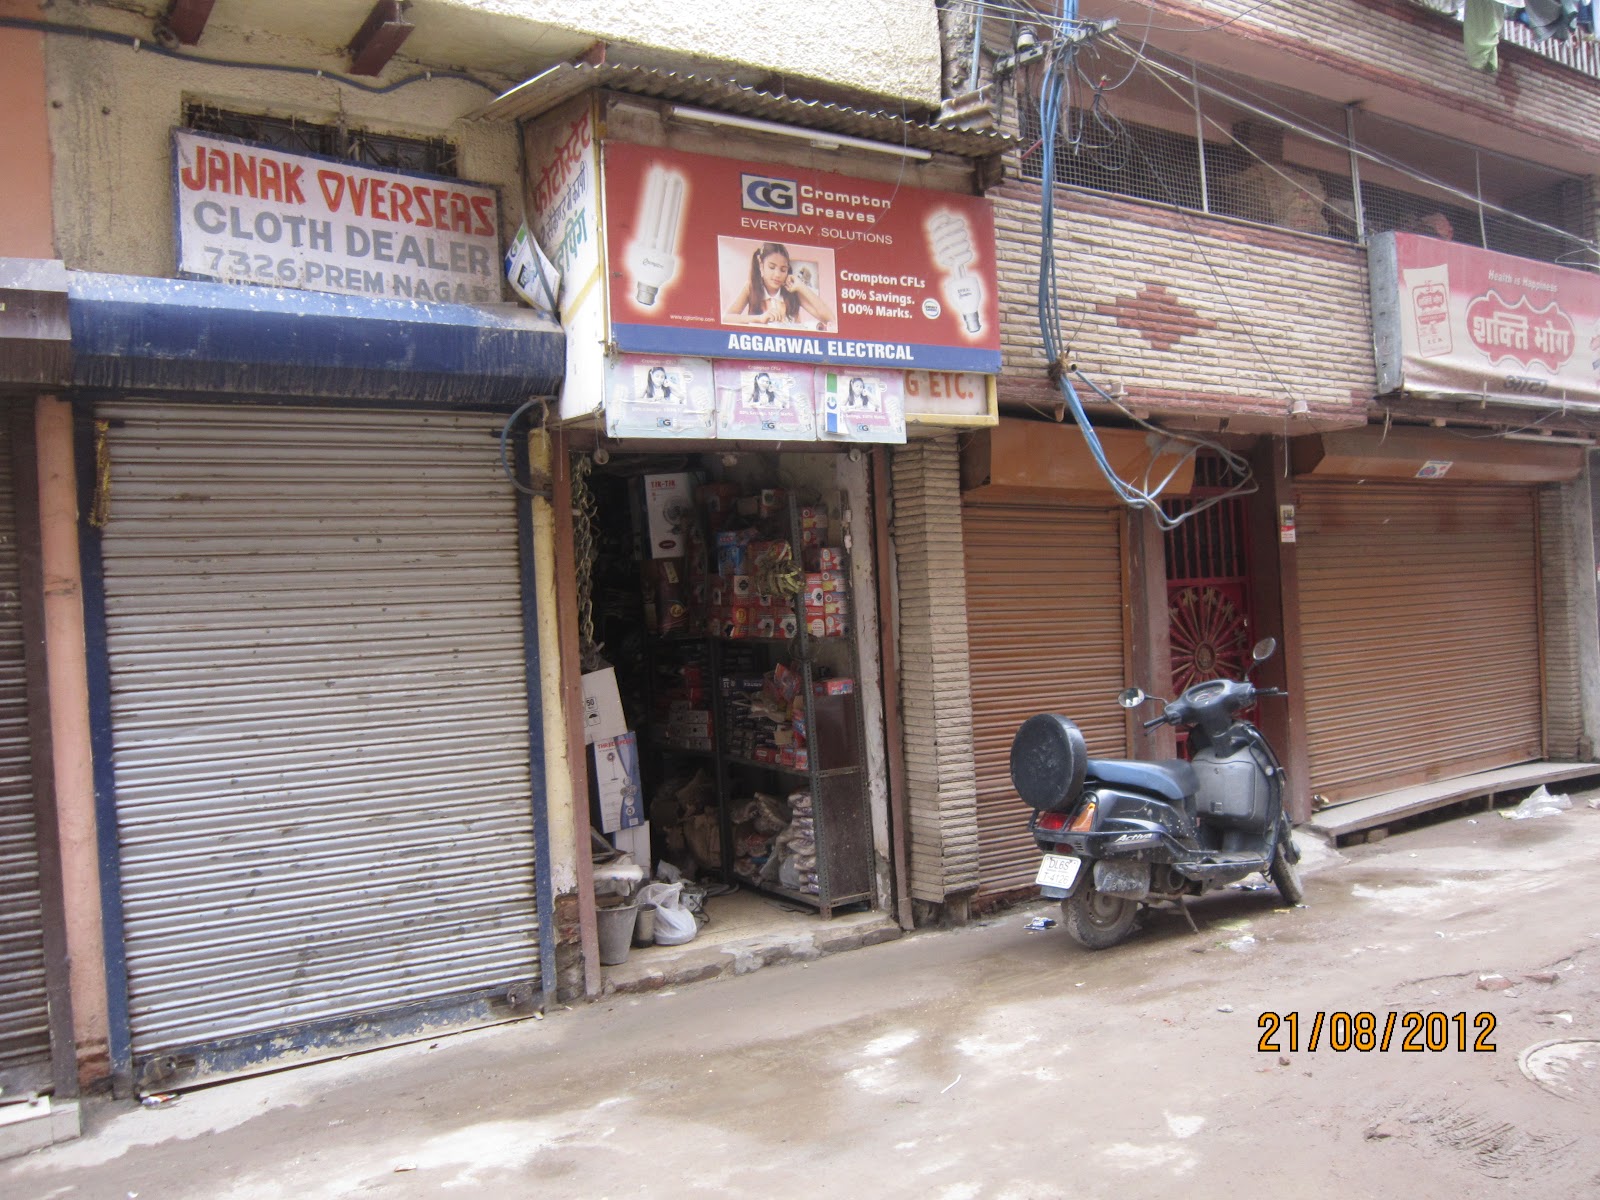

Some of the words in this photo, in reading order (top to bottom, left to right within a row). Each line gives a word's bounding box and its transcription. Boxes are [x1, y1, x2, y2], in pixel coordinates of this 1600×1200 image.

[181, 145, 306, 205] JANAK
[317, 169, 495, 237] OVERSEAS
[747, 180, 793, 210] CG
[800, 185, 891, 209] Crompton
[801, 202, 876, 223] Greaves
[193, 200, 332, 253] CLOTH
[346, 224, 491, 277] DEALER
[741, 217, 813, 236] EVERYDAY
[821, 227, 893, 245] SOLUTIONS
[204, 245, 297, 281] 7326
[305, 261, 384, 294] PREM
[840, 270, 898, 286] Crompton
[900, 275, 925, 288] CFLs
[1488, 269, 1512, 283] Health
[841, 288, 867, 300] 80%
[869, 289, 915, 306] Savings.
[841, 303, 873, 316] 100%
[875, 305, 912, 319] Marks.
[728, 333, 823, 355] AGGARWAL
[828, 340, 914, 361] ELECTRCAL
[1473, 312, 1528, 350] शक्ति
[1534, 320, 1569, 356] भोग
[905, 369, 920, 397] G
[928, 370, 974, 399] ETC.
[1114, 833, 1153, 843] Activa
